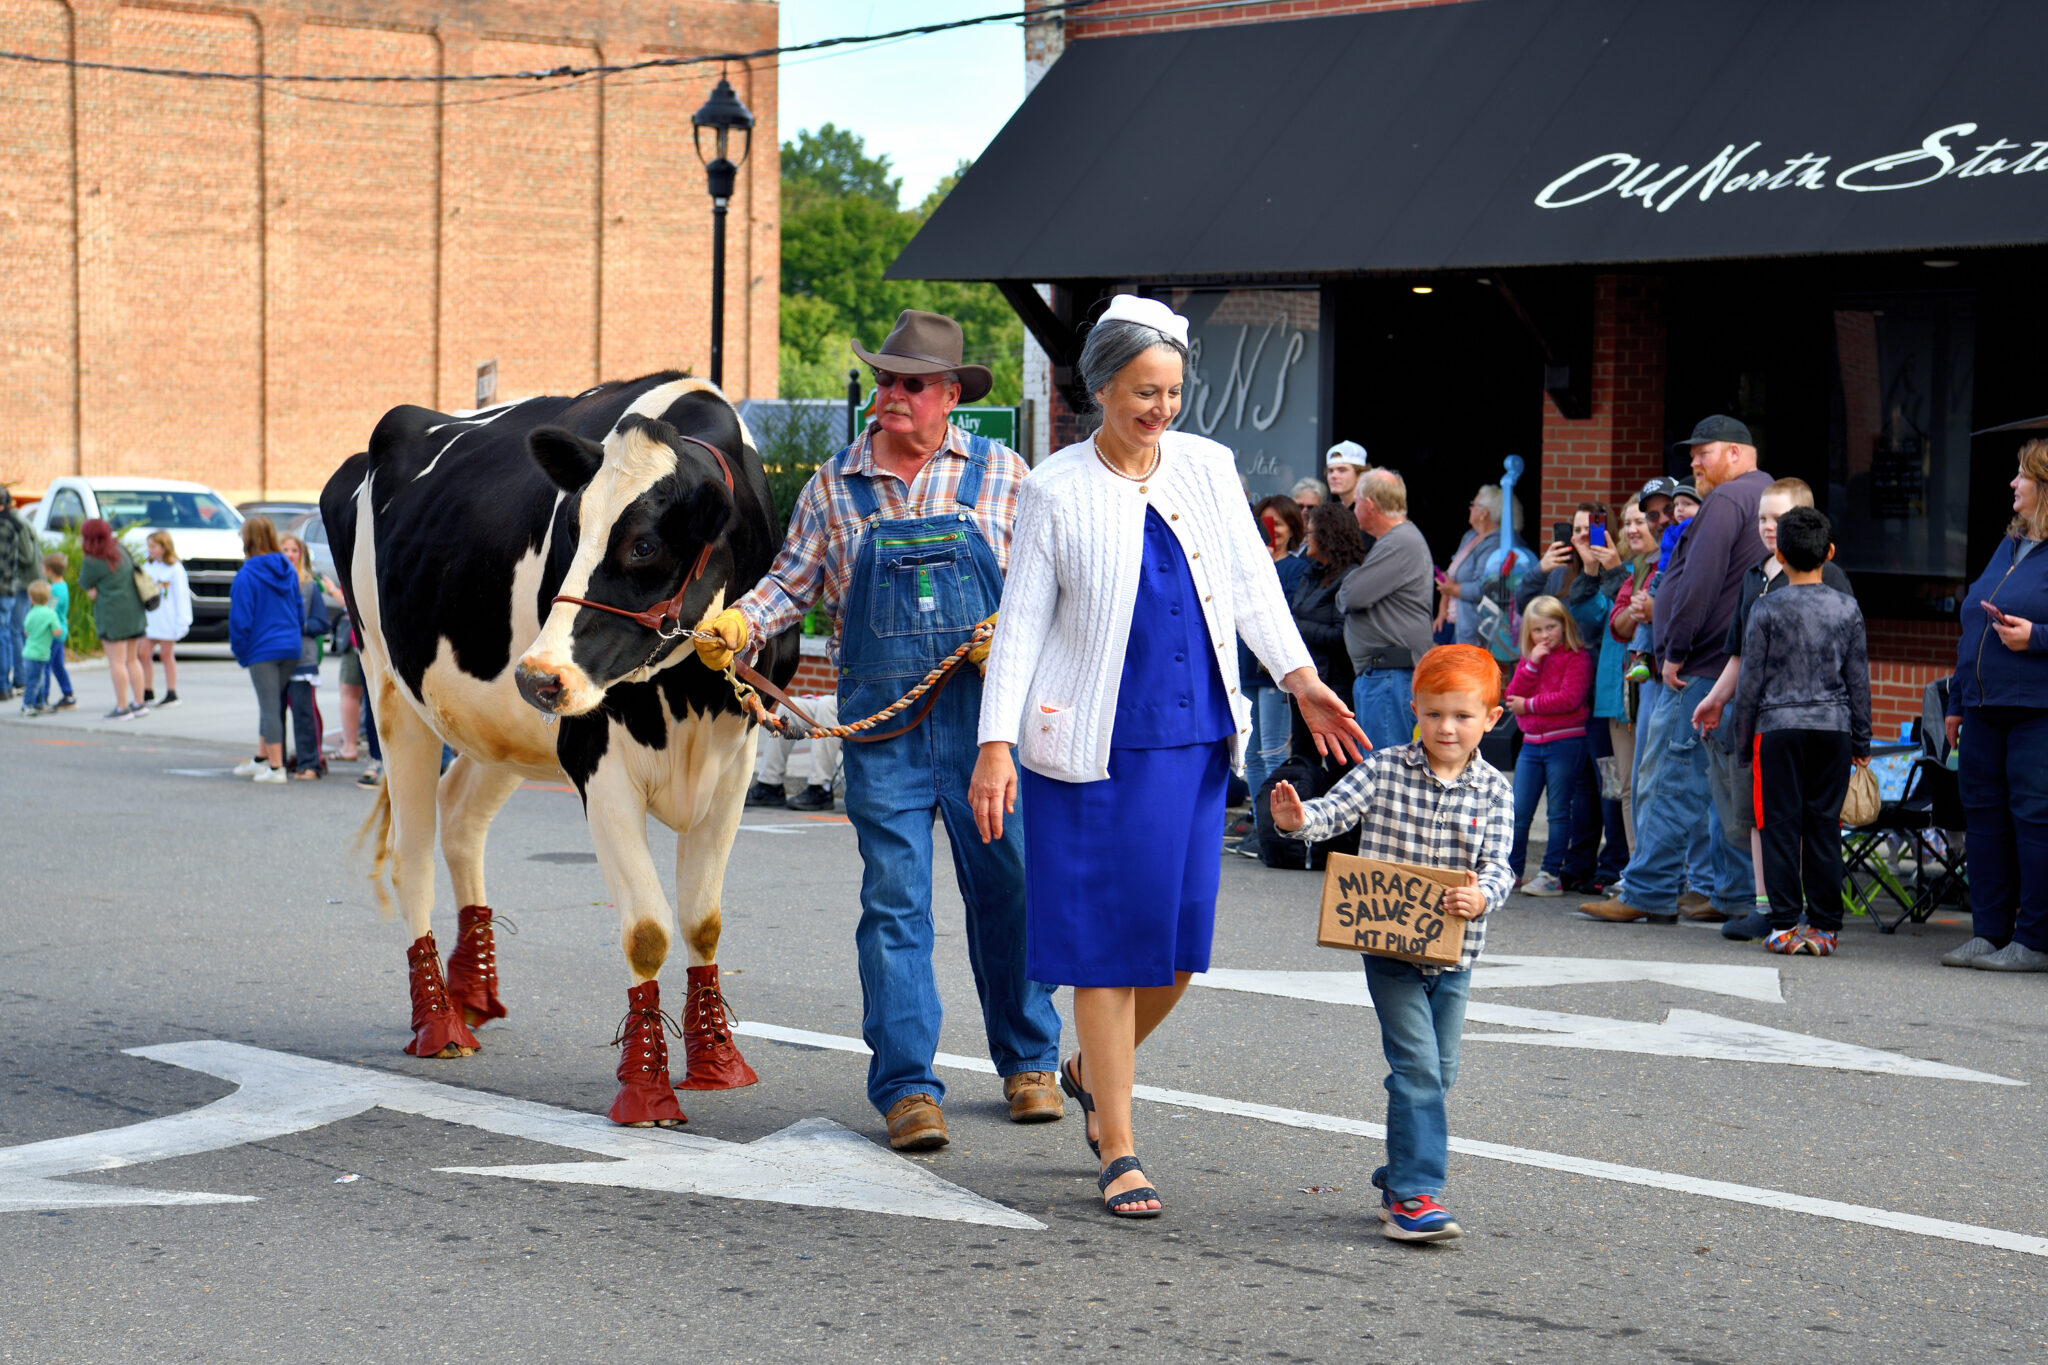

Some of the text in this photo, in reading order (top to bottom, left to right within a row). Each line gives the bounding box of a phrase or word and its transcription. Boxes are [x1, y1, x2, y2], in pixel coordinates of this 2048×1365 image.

[1534, 152, 1689, 209] Old
[1656, 140, 1832, 213] North
[956, 414, 981, 434] Airy
[1336, 898, 1415, 927] SALVE
[1354, 928, 1433, 956] MT PILOT
